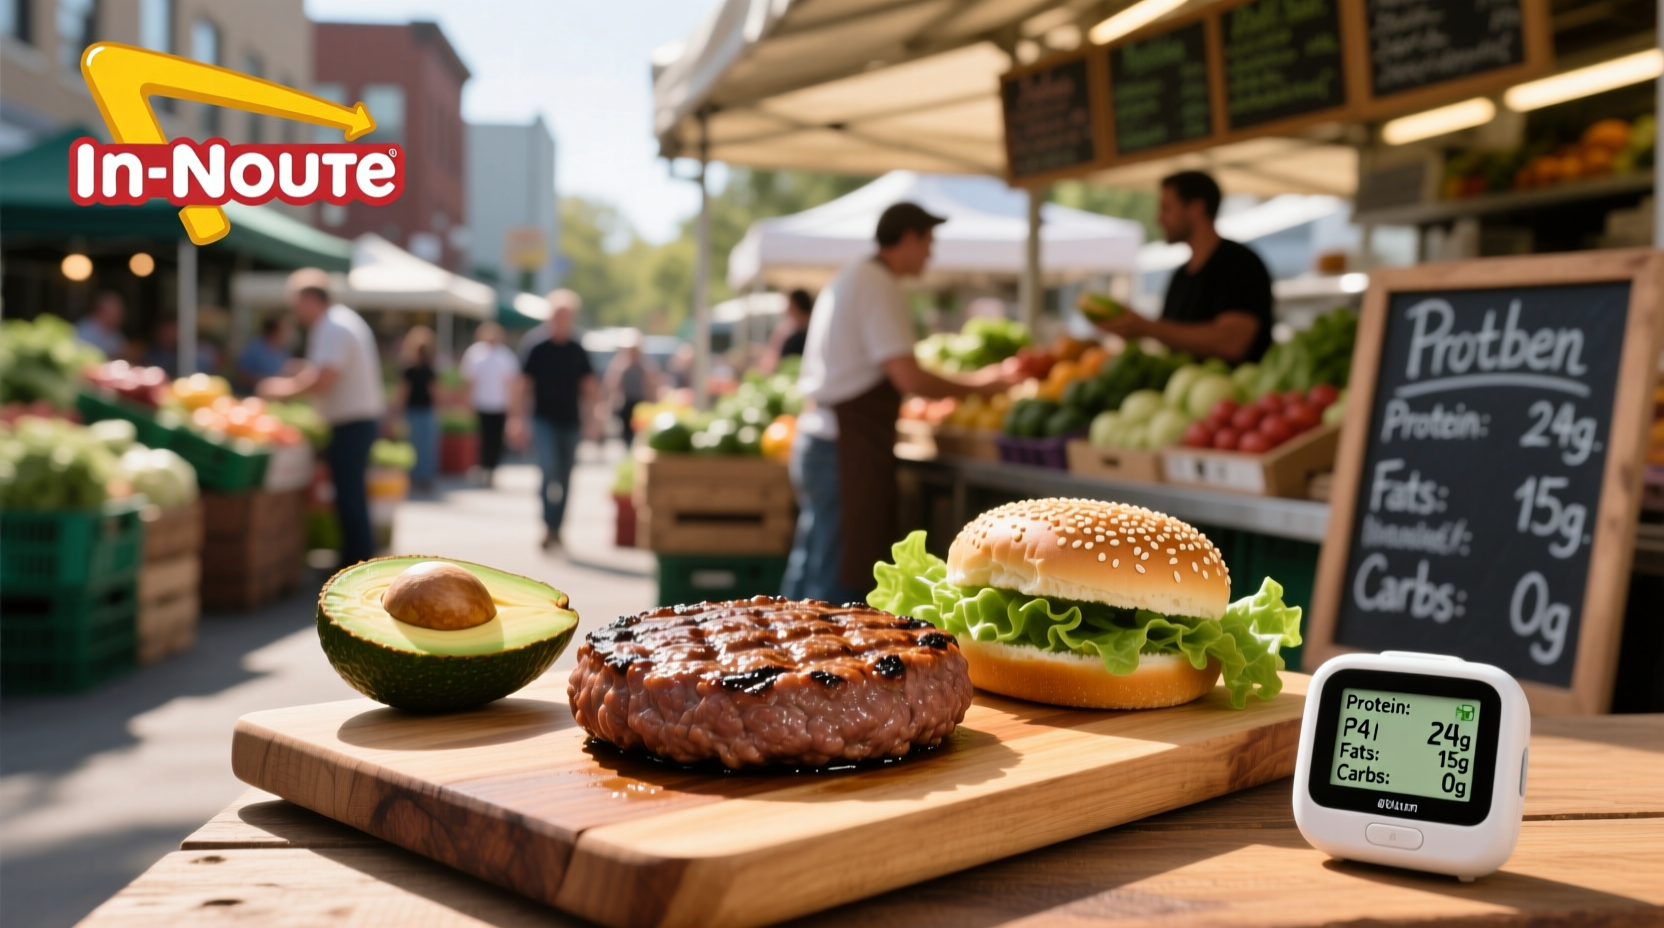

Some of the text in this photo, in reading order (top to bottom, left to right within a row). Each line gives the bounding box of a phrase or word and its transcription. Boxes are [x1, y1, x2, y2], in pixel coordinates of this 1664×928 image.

[1405, 298, 1587, 380] Protben
[1381, 398, 1491, 443] Protein:
[1369, 458, 1449, 514] Fats:
[1353, 553, 1571, 665] Carbs: 0g
[1346, 694, 1410, 715] Protein:
[1427, 721, 1471, 752] 24g
[1340, 742, 1469, 774] Fats: 15g
[1337, 763, 1467, 798] Carbs: 0g
